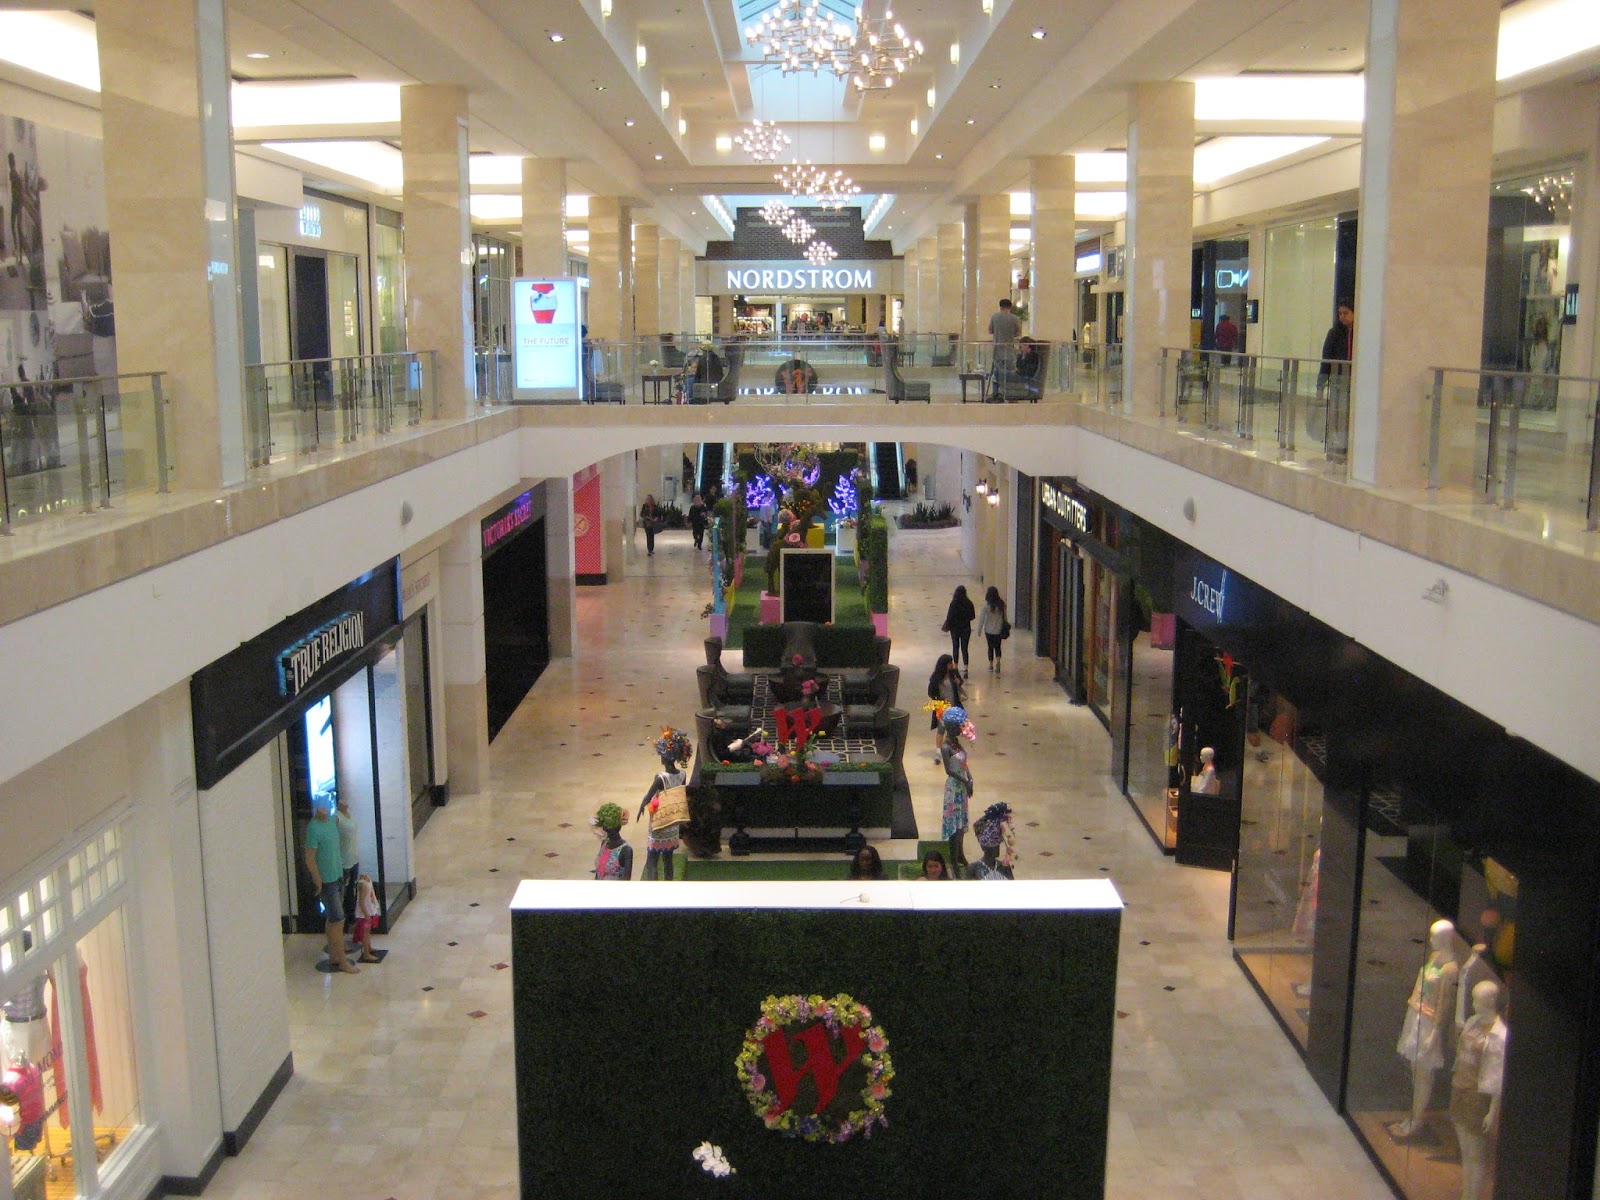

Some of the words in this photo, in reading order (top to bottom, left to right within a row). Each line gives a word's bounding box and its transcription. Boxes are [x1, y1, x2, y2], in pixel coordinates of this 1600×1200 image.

[727, 269, 872, 289] NORDSTROM
[1041, 481, 1056, 512] URBAN
[1056, 490, 1087, 533] OUTFITTERS
[1190, 569, 1227, 624] J.CREW
[291, 637, 321, 696] TRUE
[321, 610, 364, 665] RELIGION
